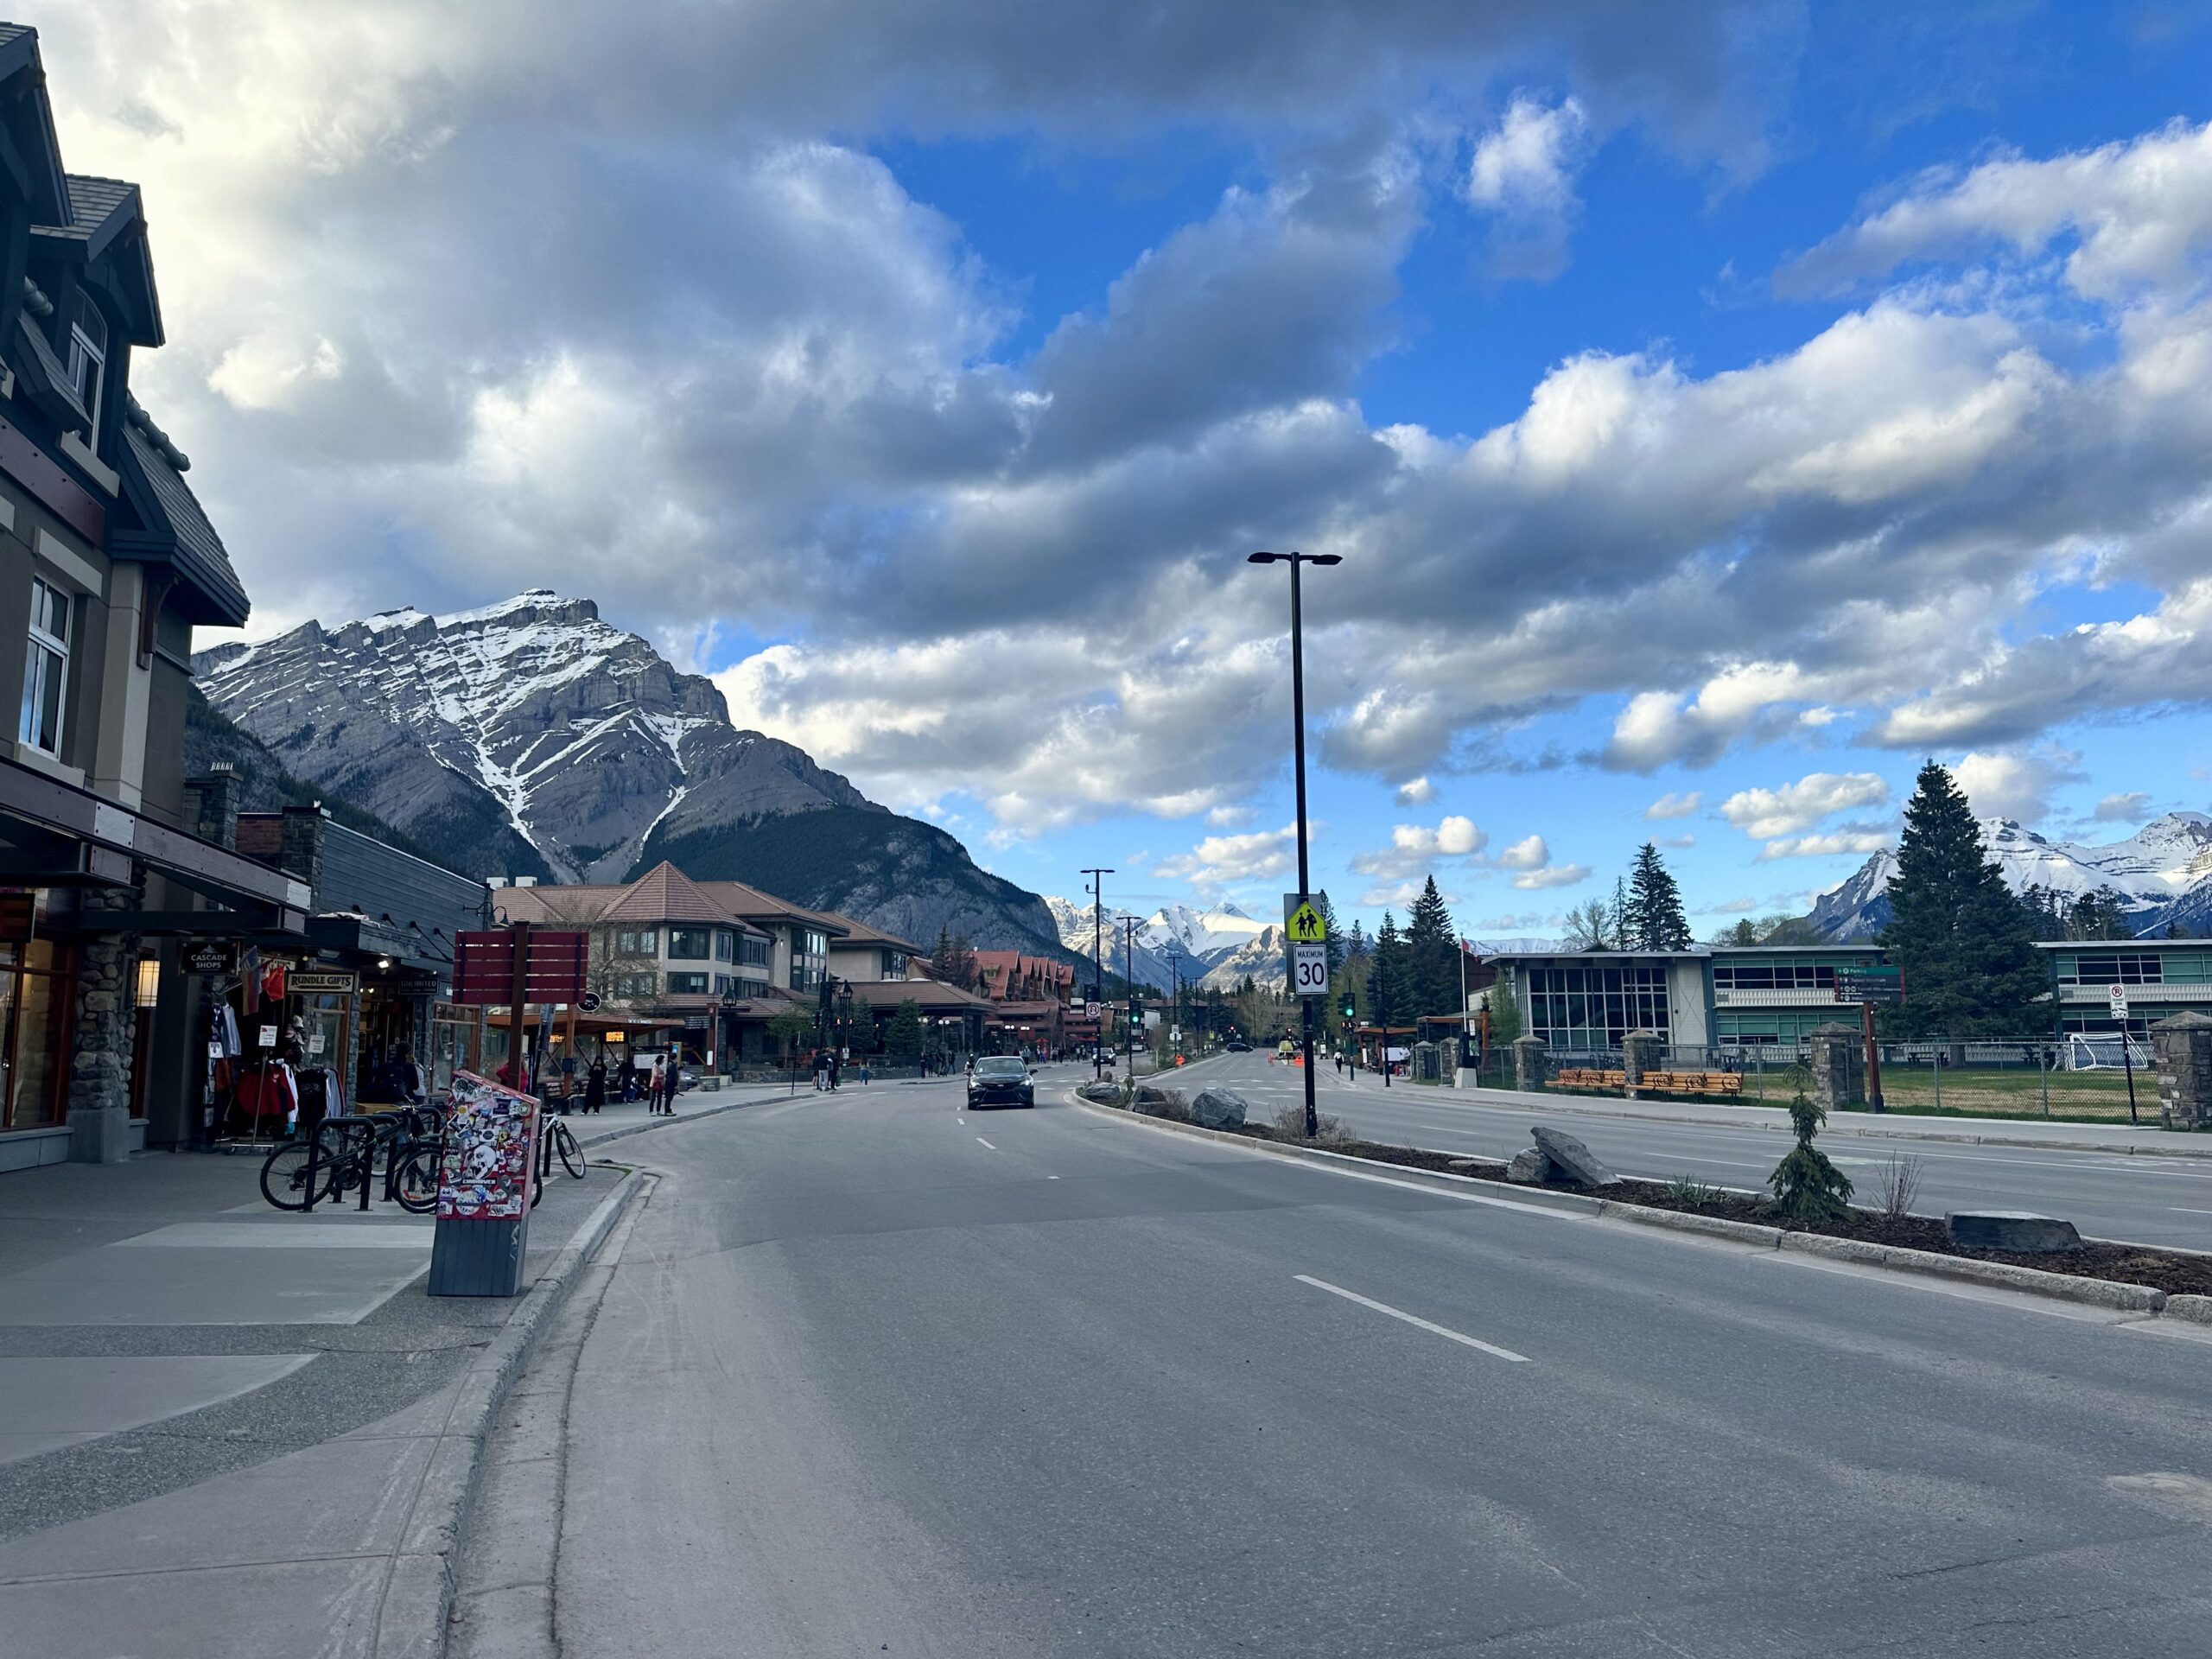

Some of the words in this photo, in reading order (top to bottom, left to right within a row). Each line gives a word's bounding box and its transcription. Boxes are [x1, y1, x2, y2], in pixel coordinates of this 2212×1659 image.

[291, 976, 325, 985] RUNDLE
[327, 976, 351, 987] GIFTS
[1299, 962, 1325, 986] 30
